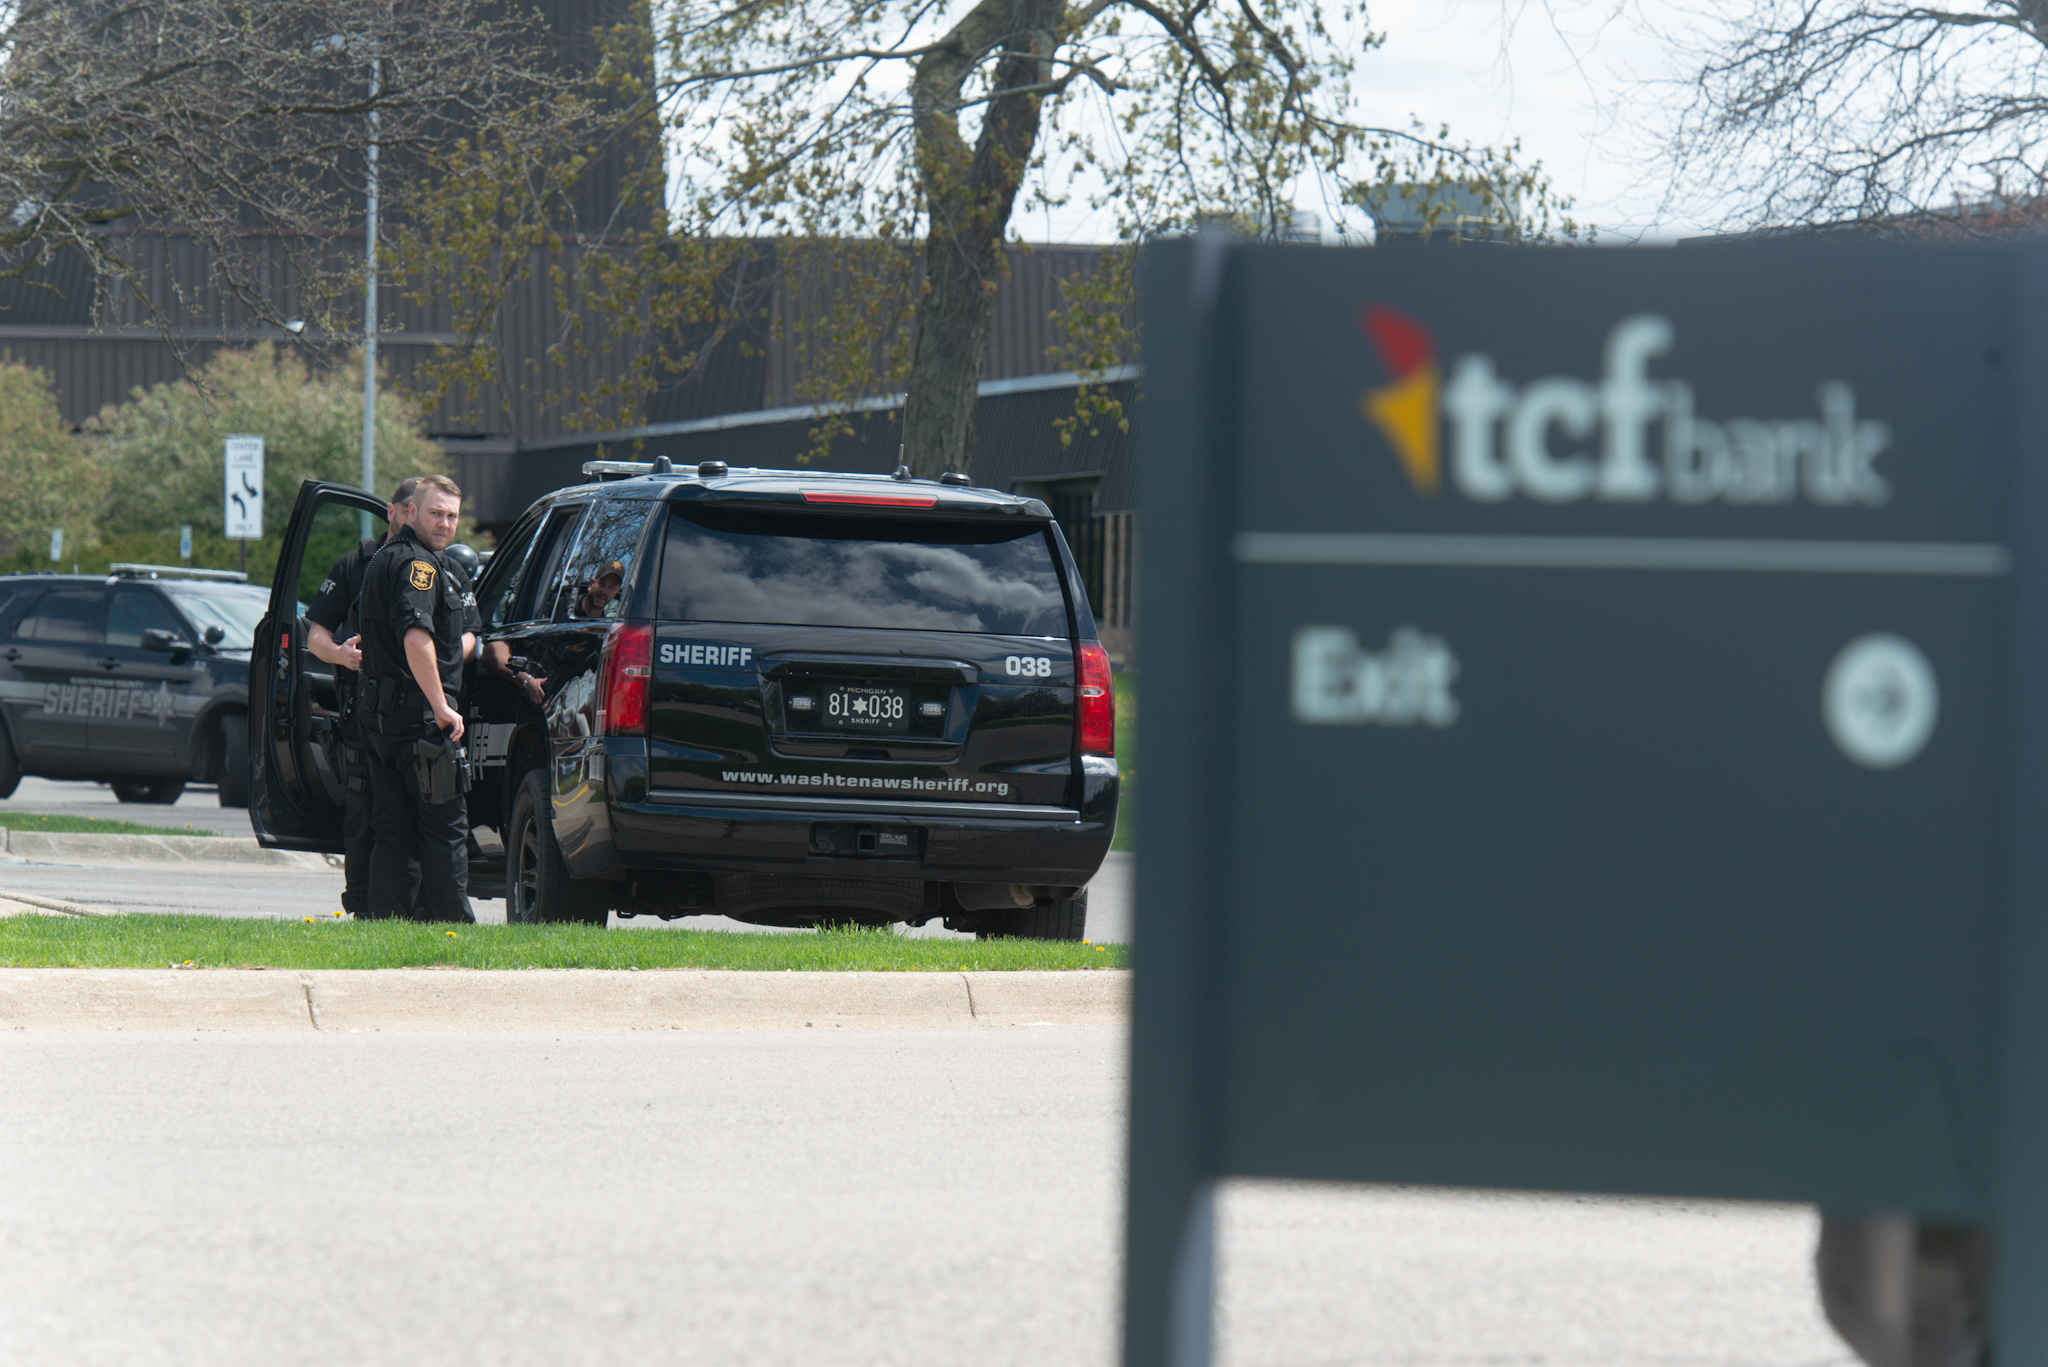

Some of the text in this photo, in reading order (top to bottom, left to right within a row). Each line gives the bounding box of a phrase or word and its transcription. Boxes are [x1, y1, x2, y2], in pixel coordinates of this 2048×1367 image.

[233, 453, 255, 463] LANE
[660, 643, 752, 667] SHERIFF
[1005, 655, 1052, 678] 038
[1290, 625, 1460, 728] Exit
[43, 682, 143, 720] SHERIFF
[847, 687, 887, 695] MICHIGAN
[851, 717, 881, 725] SHERIFF
[722, 770, 1009, 796] www.washtenawsheriff.org
